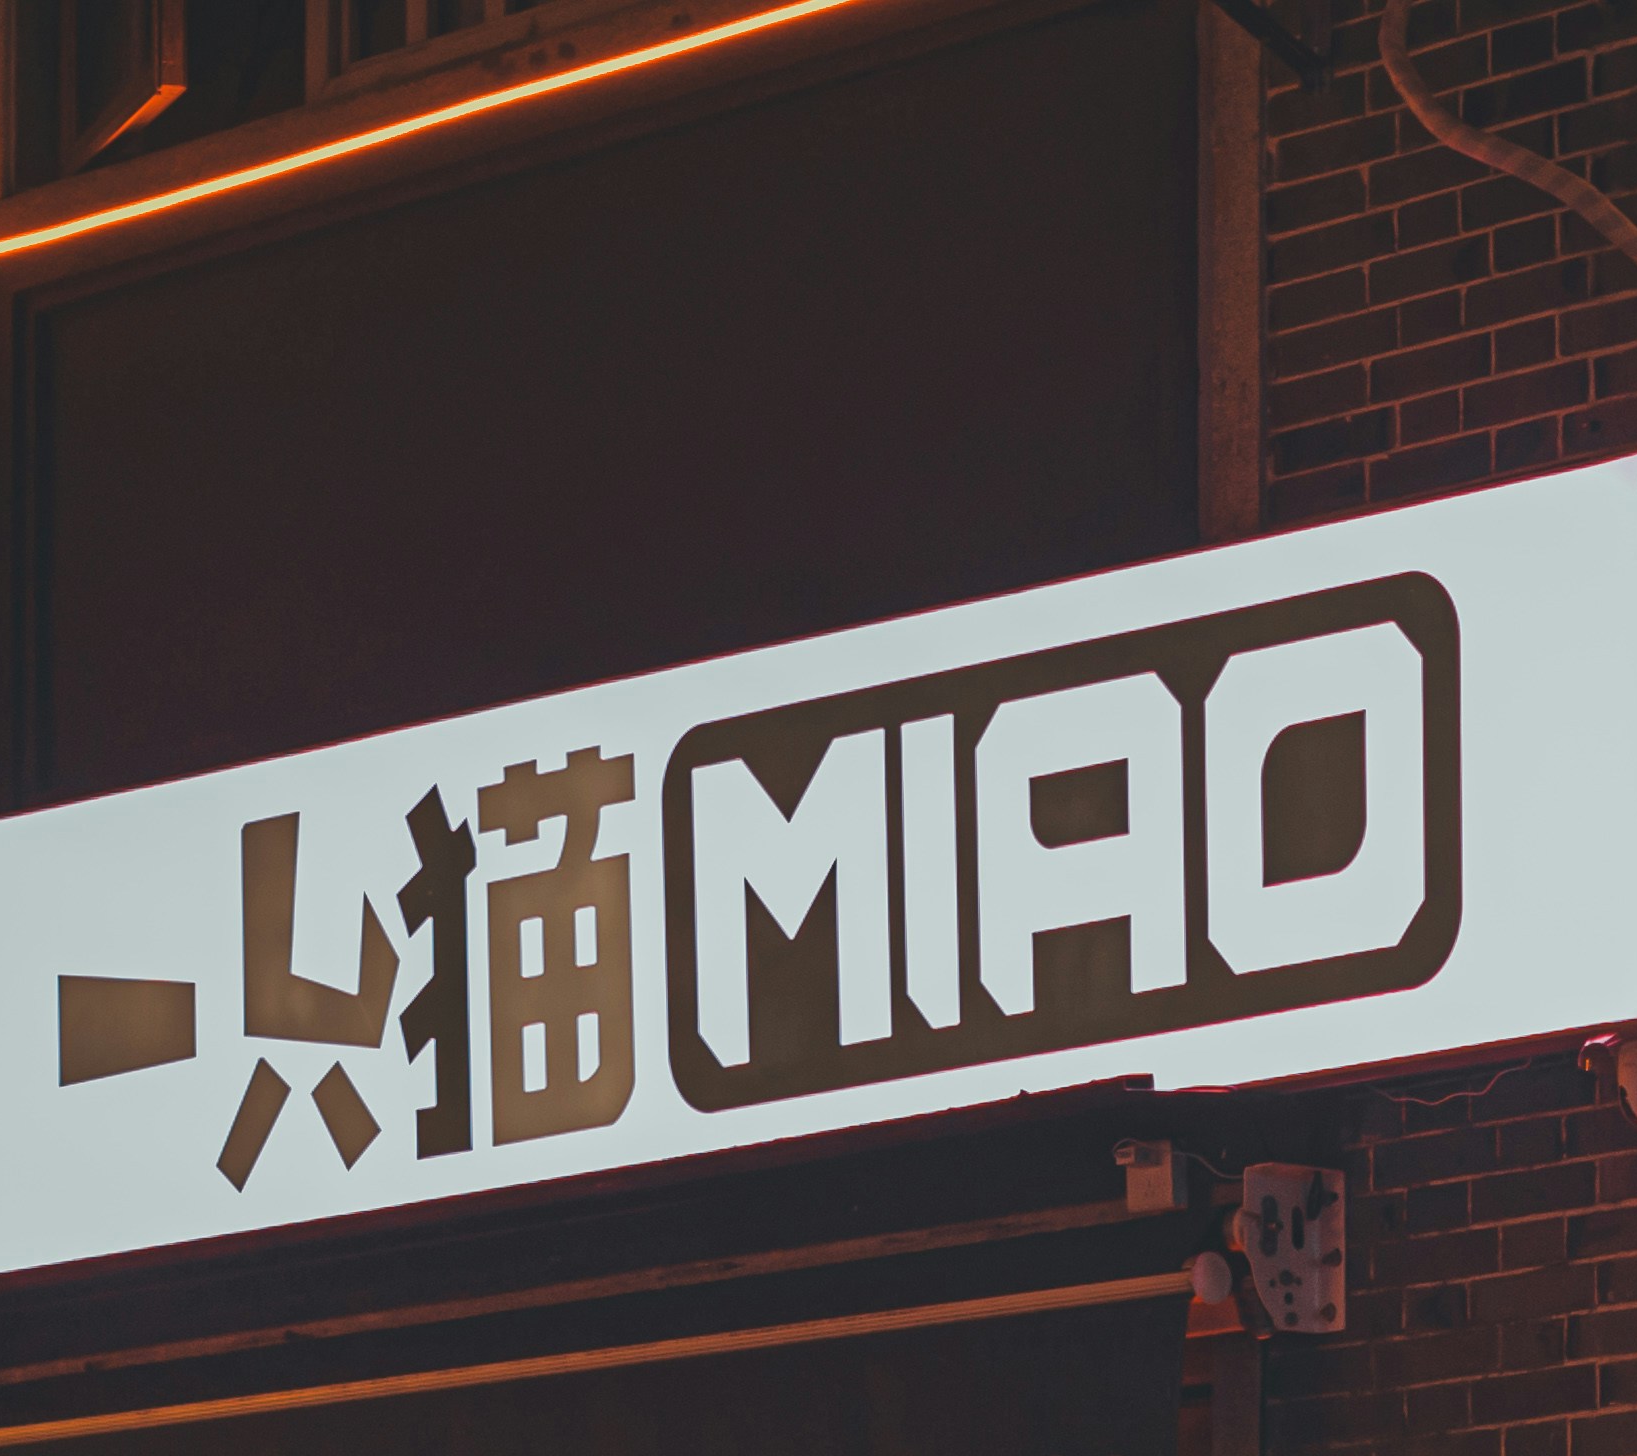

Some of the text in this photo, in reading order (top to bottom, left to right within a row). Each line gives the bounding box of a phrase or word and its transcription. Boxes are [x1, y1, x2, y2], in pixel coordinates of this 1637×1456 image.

[58, 744, 637, 1193] 一只猫
[690, 620, 1426, 1068] MIAO
